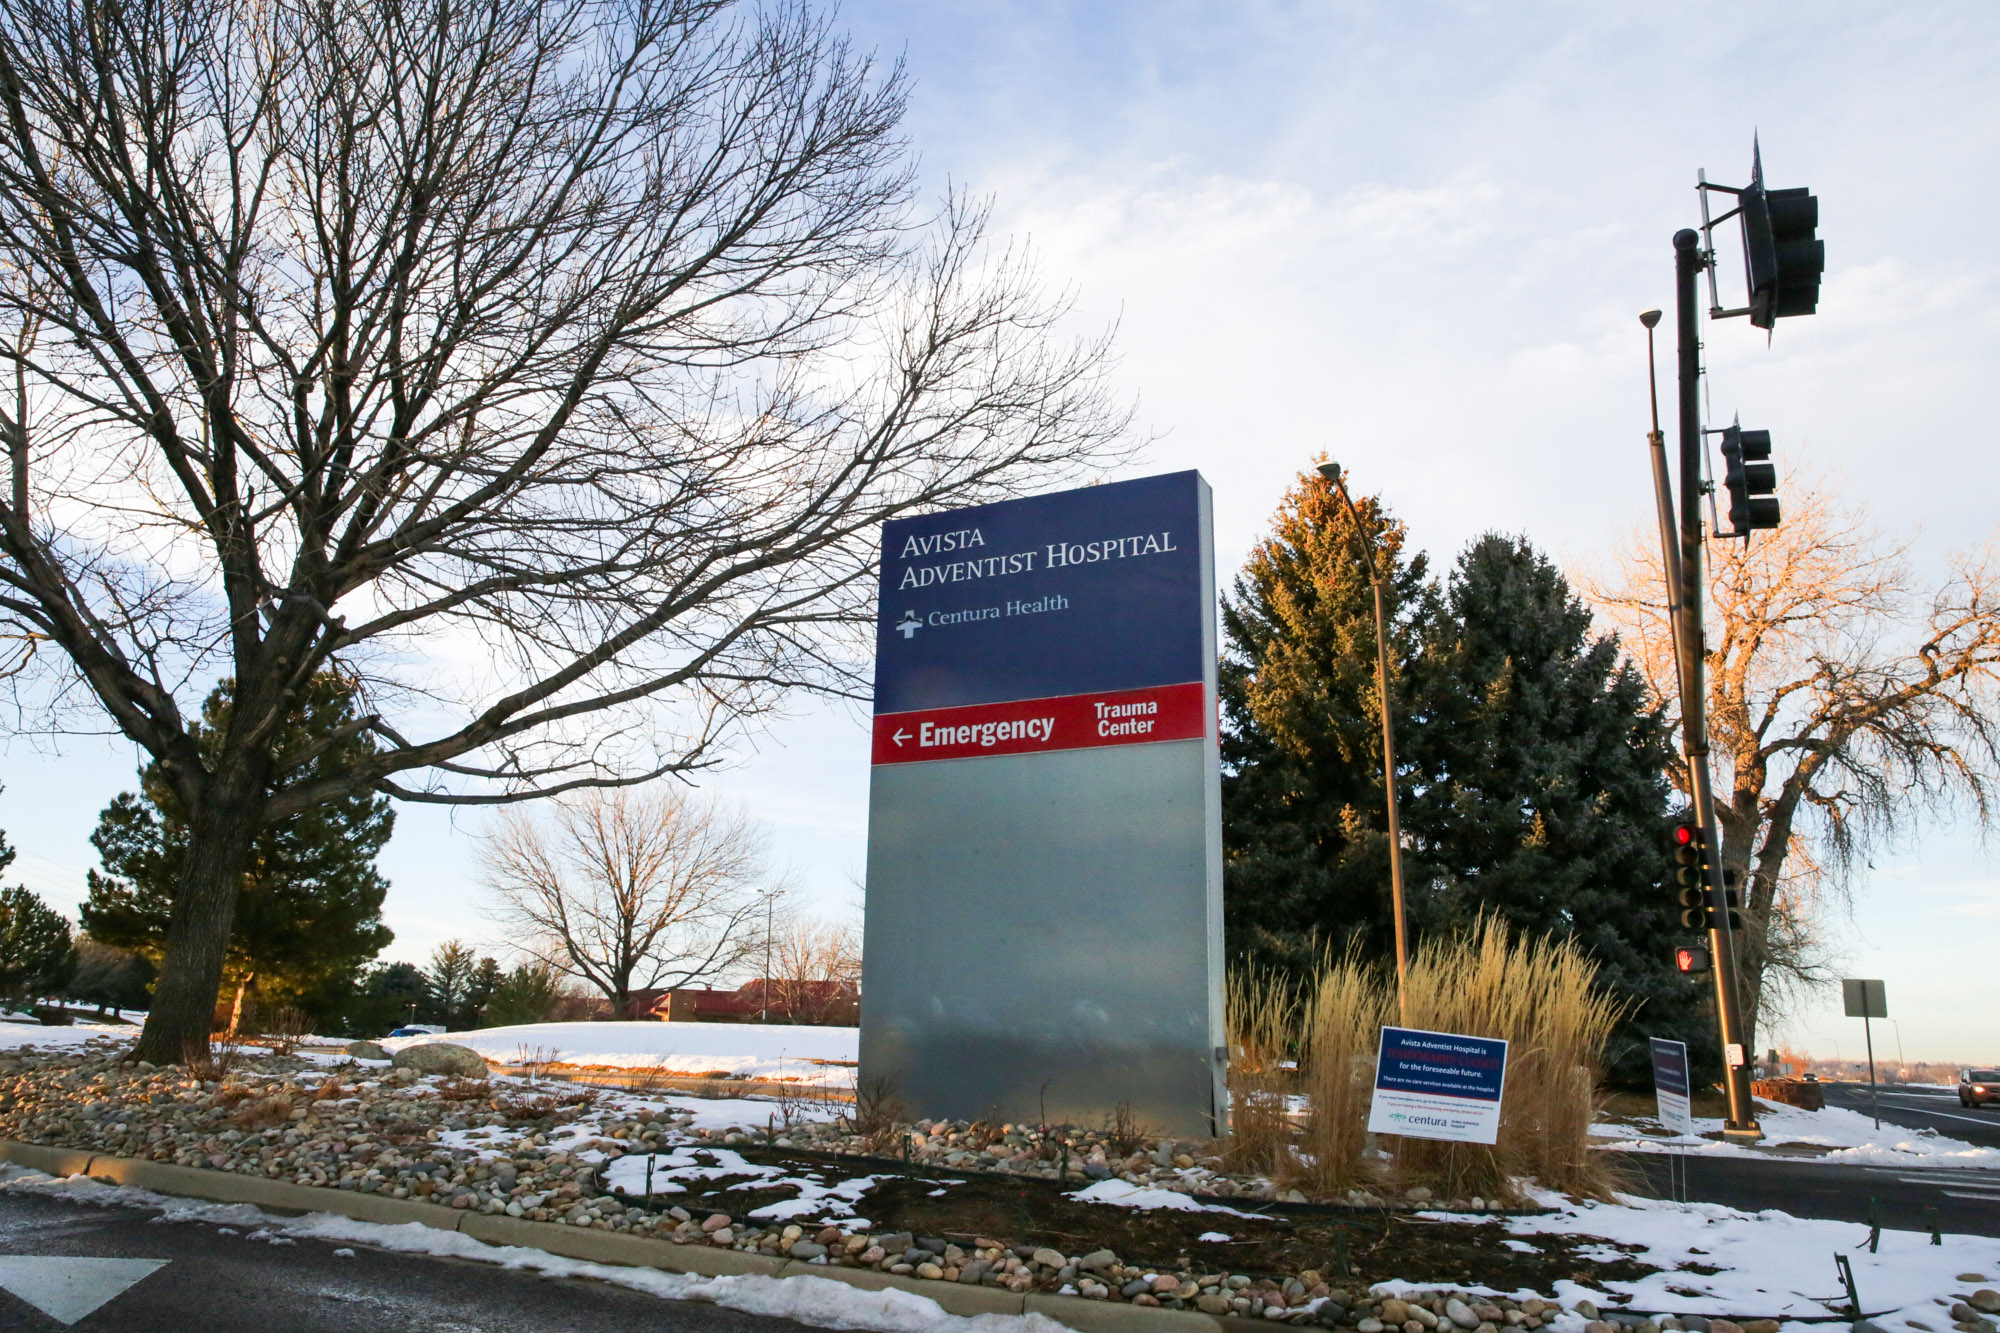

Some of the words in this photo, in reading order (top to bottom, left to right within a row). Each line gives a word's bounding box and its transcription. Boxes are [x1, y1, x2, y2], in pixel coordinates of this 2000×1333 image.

[899, 528, 987, 559] AVISTA
[898, 551, 1037, 590] ADVENTIST
[1046, 531, 1177, 568] HOSPITAL
[928, 606, 1000, 626] Centura
[1006, 594, 1069, 617] Health
[1094, 701, 1157, 719] Trauma
[919, 717, 1055, 747] Emergency
[1098, 717, 1154, 737] Center
[1401, 1039, 1420, 1048] Avista
[1421, 1041, 1452, 1051] Adventist
[1453, 1044, 1480, 1054] Hospital
[1481, 1047, 1487, 1055] is
[1399, 1061, 1409, 1069] for
[1410, 1062, 1421, 1071] the
[1422, 1063, 1459, 1075] foreseeable
[1461, 1069, 1483, 1078] future.
[1408, 1115, 1447, 1127] centura
